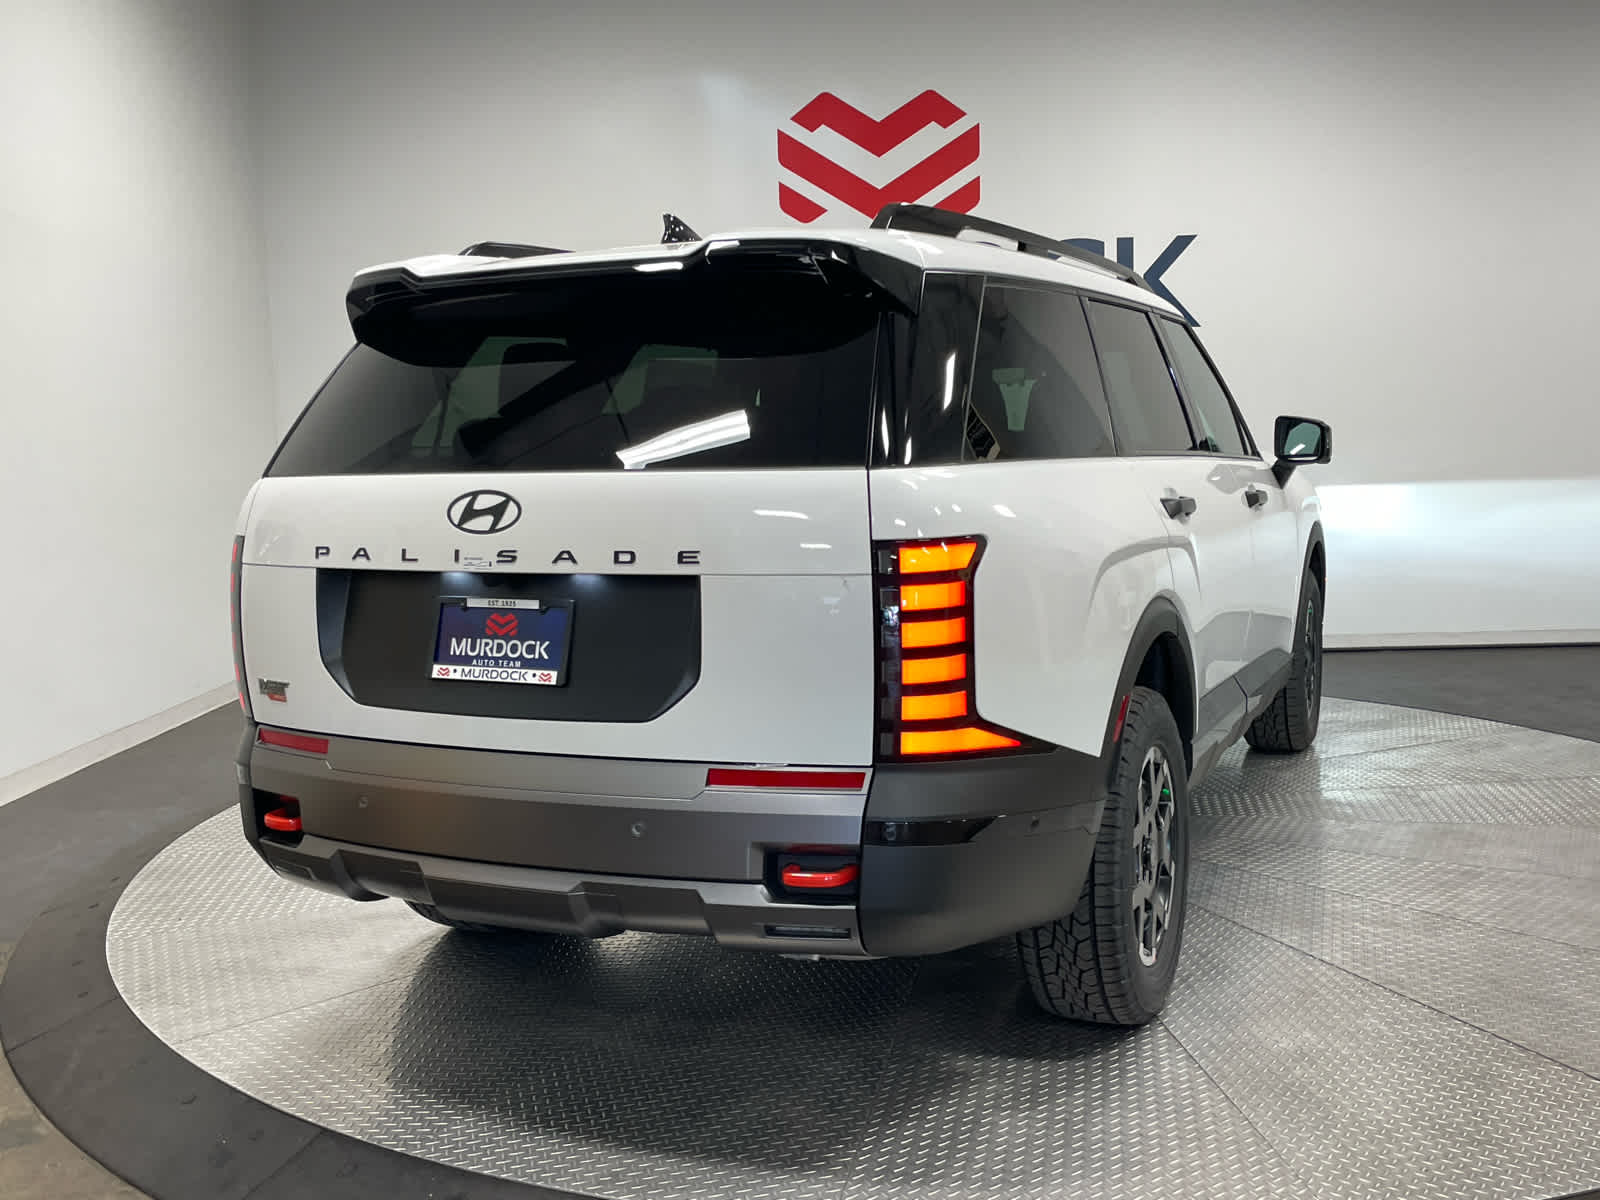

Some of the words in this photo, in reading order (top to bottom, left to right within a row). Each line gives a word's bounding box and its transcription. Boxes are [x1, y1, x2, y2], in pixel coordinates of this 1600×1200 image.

[314, 545, 701, 566] PALISADE
[450, 637, 550, 660] MURDOCK
[472, 658, 495, 667] AUTO
[499, 660, 521, 668] TEAM
[460, 668, 529, 682] MURDOCK
